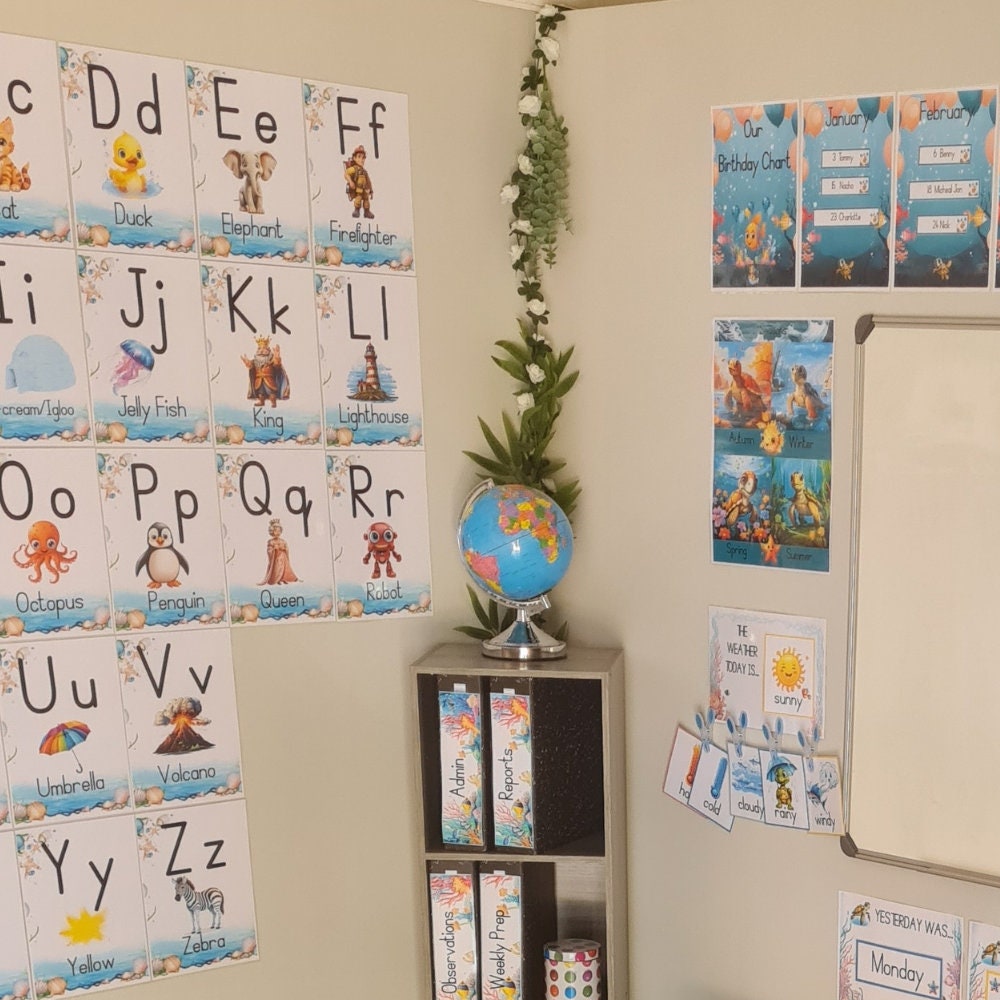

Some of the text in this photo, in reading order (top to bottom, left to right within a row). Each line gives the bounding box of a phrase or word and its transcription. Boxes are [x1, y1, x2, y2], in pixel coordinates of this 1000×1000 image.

[825, 107, 869, 132] January
[920, 100, 975, 126] February
[744, 120, 762, 138] Our
[719, 150, 791, 178] Birthday Chart
[0, 197, 19, 220] at
[114, 202, 152, 228] Duck
[222, 213, 284, 243] Elephant
[330, 220, 397, 251] Firefighter
[118, 396, 187, 425] Jelly Fish
[253, 407, 283, 435] King
[339, 404, 409, 431] Lighthouse
[726, 543, 747, 560] Spring
[261, 590, 305, 609] Queen
[366, 581, 402, 601] Robot
[16, 592, 84, 619] Octopus
[148, 591, 205, 617] Penguin
[737, 625, 748, 637] THE
[727, 642, 758, 657] WEATHER
[726, 661, 746, 675] TODAY
[774, 695, 803, 712] sunny
[37, 772, 105, 797] Umbrella
[157, 764, 216, 784] Volcano
[451, 758, 465, 798] Admin
[499, 748, 520, 801] Reports
[679, 783, 691, 800] ho
[704, 800, 721, 815] cold
[738, 797, 764, 820] cloudy
[775, 807, 797, 825] rainy
[815, 813, 835, 832] windy
[875, 908, 922, 932] YESTERDAY
[182, 932, 226, 955] Zebra
[441, 911, 456, 994] Observations
[489, 909, 511, 989] Weekly Prep
[67, 955, 115, 977] Yellow
[871, 950, 924, 991] Monday
